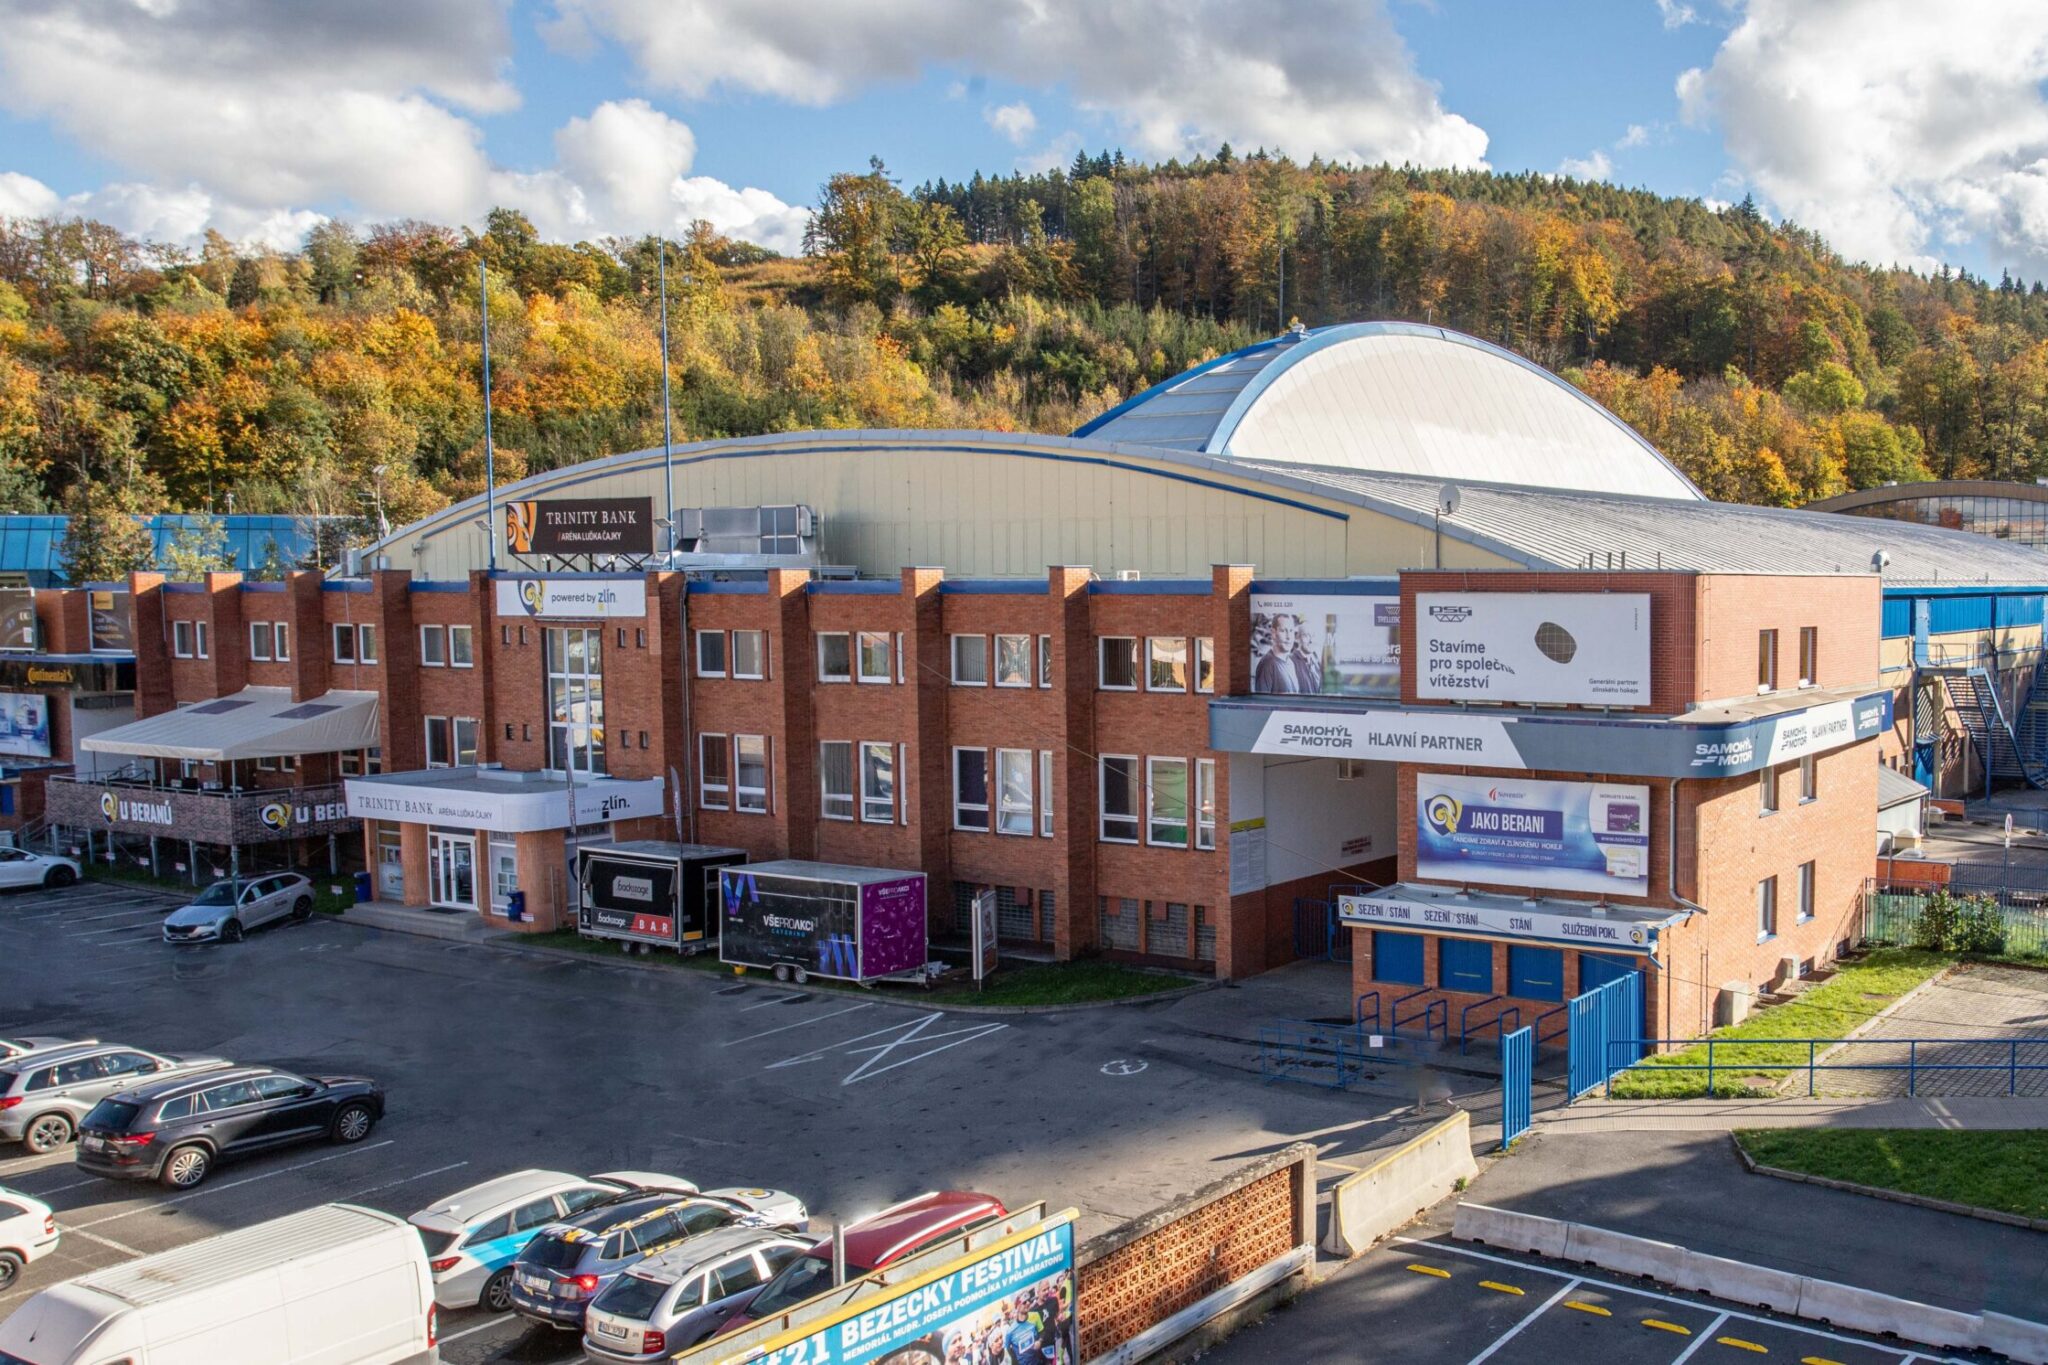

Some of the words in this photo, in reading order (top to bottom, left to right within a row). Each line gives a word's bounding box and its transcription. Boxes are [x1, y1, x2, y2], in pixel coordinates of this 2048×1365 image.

[546, 511, 597, 525] TRINITY
[602, 510, 637, 524] BANK
[551, 593, 585, 603] powered
[586, 592, 596, 604] by
[598, 588, 616, 603] zlín
[1429, 639, 1485, 653] Stavíme
[1430, 660, 1452, 673] pro
[1430, 674, 1489, 688] vítězství
[1283, 724, 1352, 737] SAMOHÝL
[1828, 719, 1848, 736] PARTNER
[1301, 736, 1352, 748] MOTOR
[1368, 731, 1416, 748] HLAVNÍ
[1421, 735, 1483, 751] PARTNER
[1695, 737, 1753, 755] SAMOHÝL
[1788, 736, 1807, 749] MOTOR
[1718, 750, 1752, 767] MOTOR
[119, 800, 128, 821] U
[131, 799, 172, 825] BERANŮ
[358, 796, 401, 811] TRINITY
[405, 801, 433, 815] BANK
[295, 806, 309, 823] U
[1471, 812, 1499, 830] JAKO
[1502, 814, 1544, 833] BERANI
[1358, 903, 1383, 917] SEZENÍ
[1390, 906, 1410, 919] STÁNÍ
[1424, 910, 1450, 923] SEZENÍ
[1456, 912, 1479, 926] STÁNÍ
[1509, 917, 1532, 931] STÁNÍ
[1562, 922, 1598, 938] SLUŽEBNÍ
[960, 1230, 1063, 1294] FESTIVAL
[843, 1330, 891, 1362] MEMORIÁL
[893, 1319, 921, 1337] MUDR.
[922, 1306, 952, 1326] JOSEFA
[954, 1282, 1000, 1310] PODMOLÍKA
[1001, 1277, 1009, 1288] V
[1009, 1252, 1064, 1285] PŮLMARATONU
